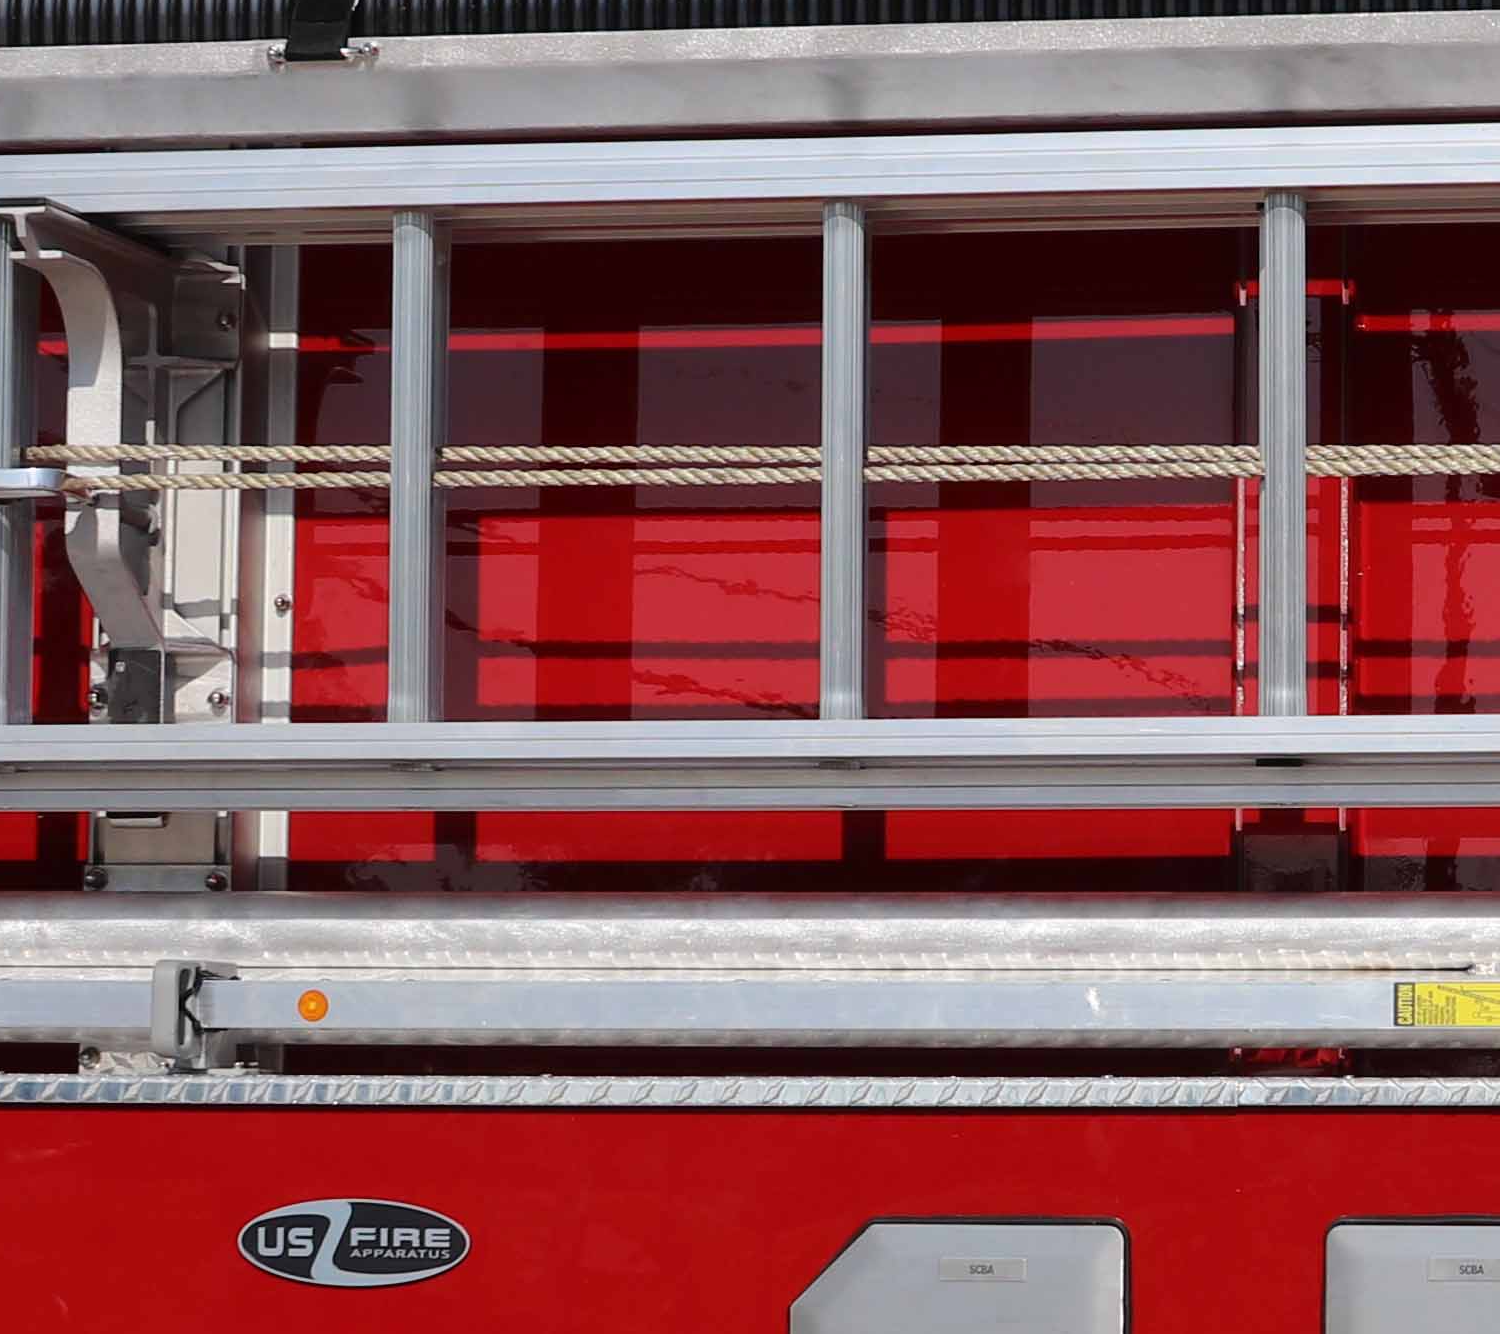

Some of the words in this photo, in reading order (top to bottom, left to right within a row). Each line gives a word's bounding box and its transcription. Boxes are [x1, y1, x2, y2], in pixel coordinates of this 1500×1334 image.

[1396, 984, 1413, 1025] CAUTION
[257, 1226, 314, 1257] US
[350, 1227, 451, 1248] FIRE
[350, 1249, 450, 1259] APPARATUS
[969, 1265, 994, 1275] SCBA
[1460, 1265, 1484, 1275] SCBA
